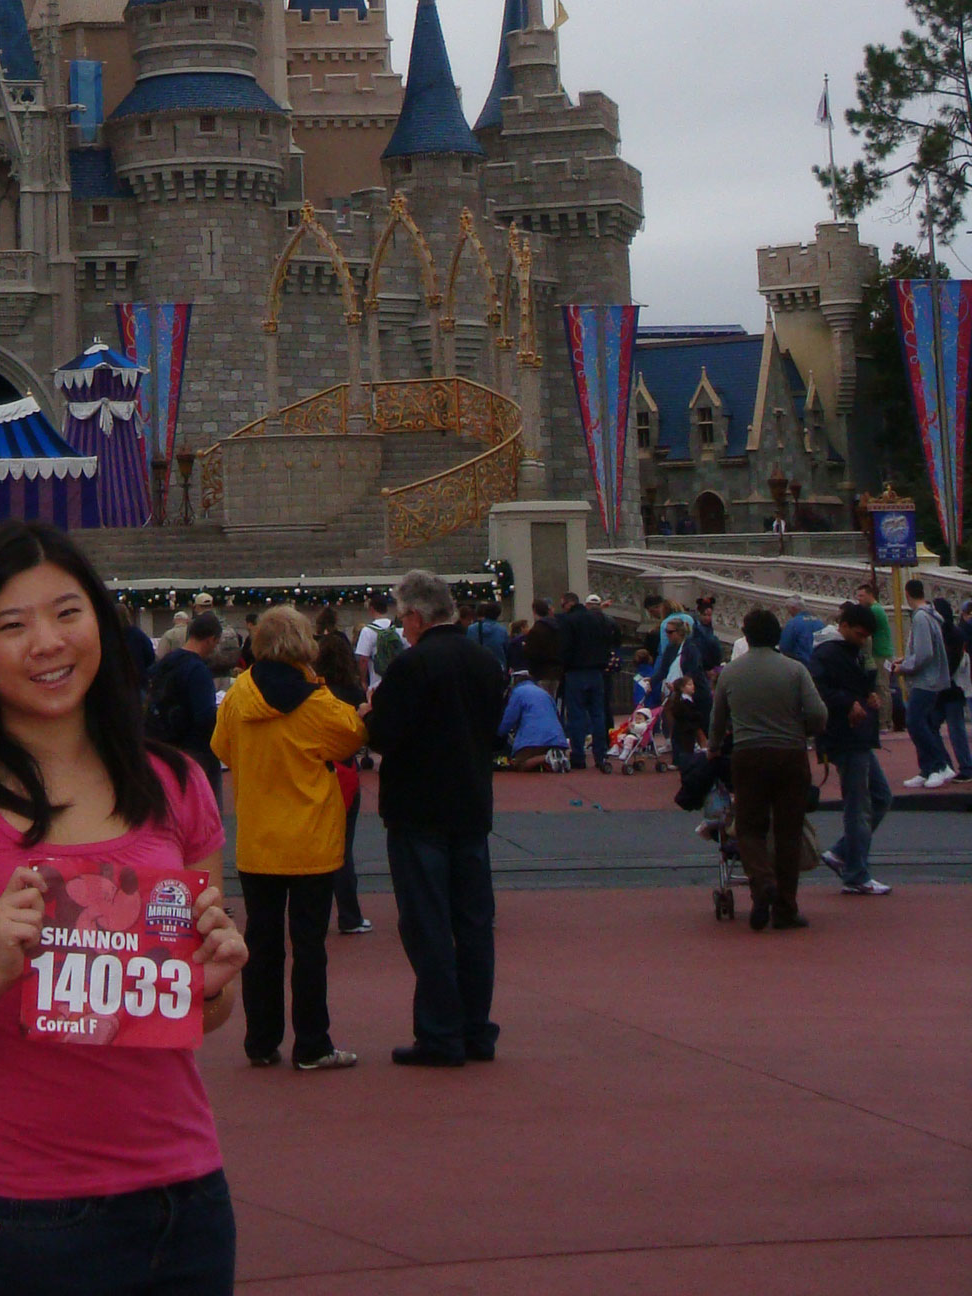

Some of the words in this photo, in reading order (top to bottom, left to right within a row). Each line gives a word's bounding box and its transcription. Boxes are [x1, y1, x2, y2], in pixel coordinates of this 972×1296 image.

[41, 927, 139, 952] SHANNON
[31, 951, 192, 1019] 14033
[36, 1015, 85, 1034] Corral
[89, 1018, 98, 1034] F
